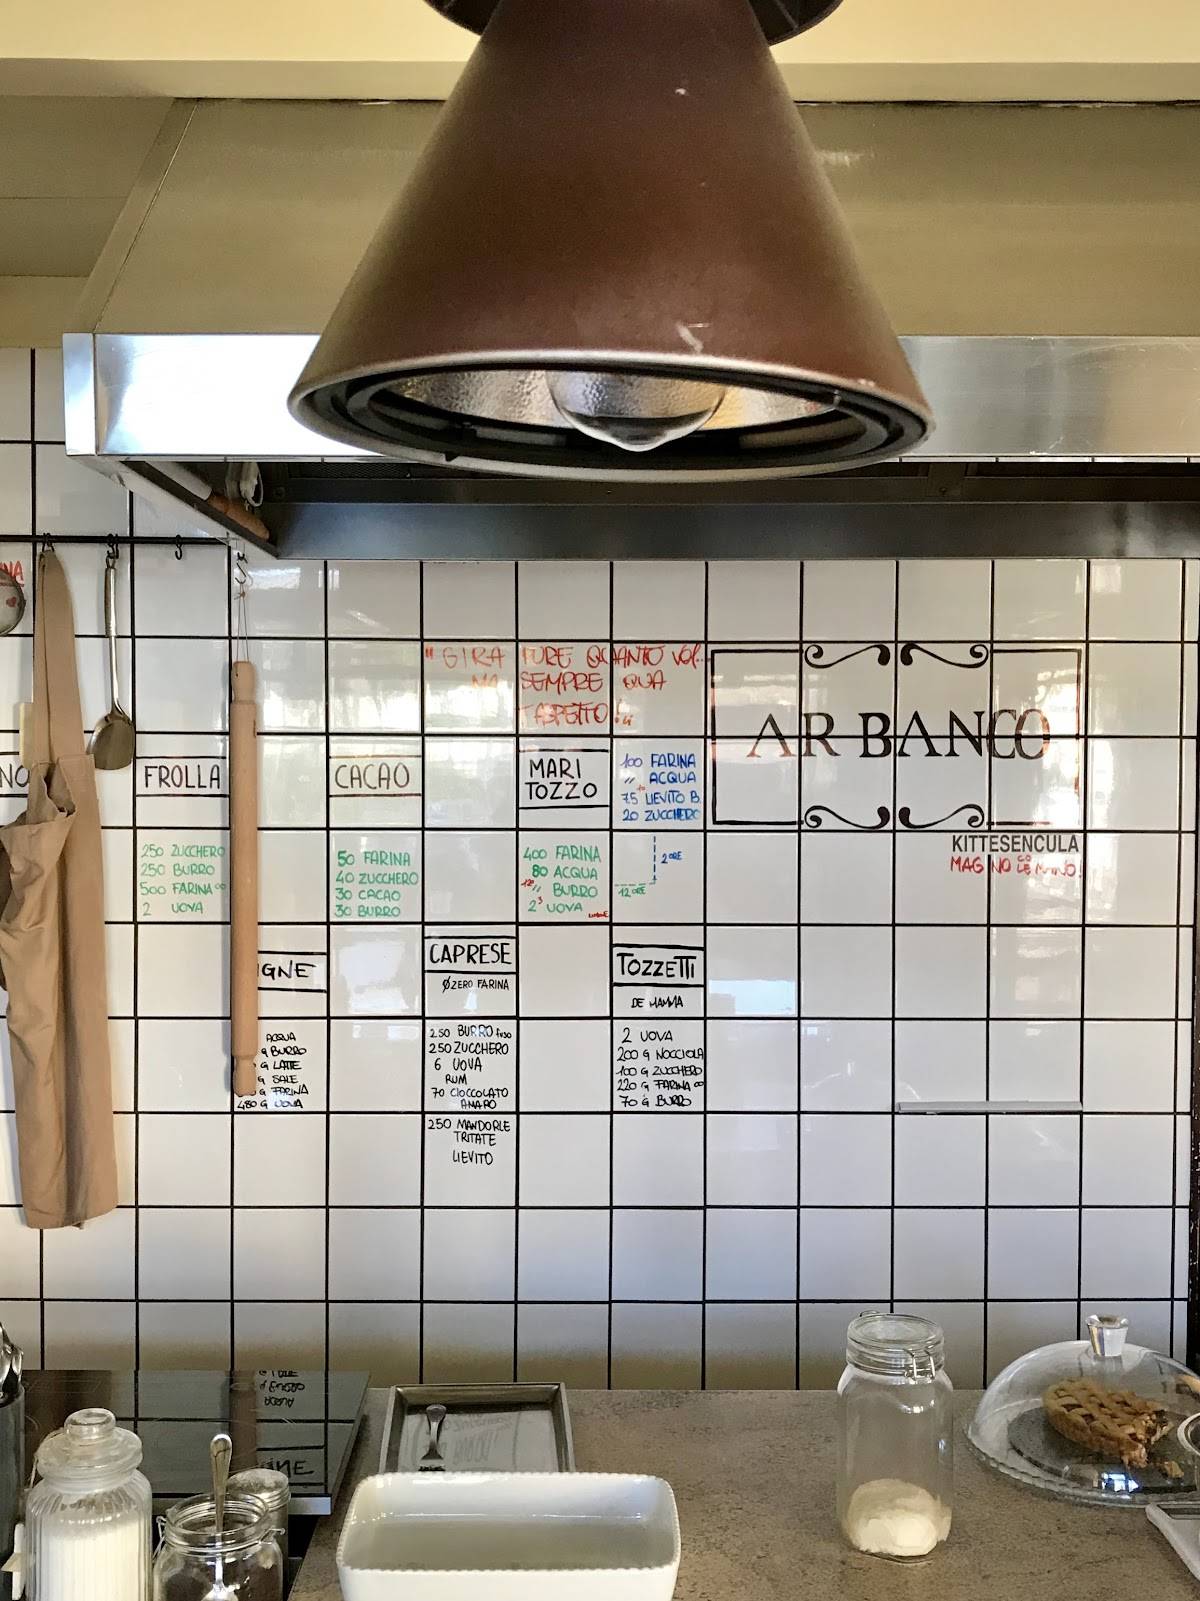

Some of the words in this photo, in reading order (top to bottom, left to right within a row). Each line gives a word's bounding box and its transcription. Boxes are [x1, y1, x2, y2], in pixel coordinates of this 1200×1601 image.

[587, 644, 665, 669] QUANTO
[521, 671, 603, 695] SEMPRE
[623, 670, 667, 690] QUA
[746, 712, 840, 757] AR
[859, 708, 1050, 759] BANCO
[620, 753, 642, 768] 100
[651, 753, 696, 768] FARINA
[335, 762, 410, 789] CACAO
[530, 758, 580, 779] MARI
[144, 764, 220, 789] FROLLA
[650, 772, 696, 784] ACQUA
[525, 782, 597, 800] TOZZO
[646, 790, 685, 805] LIEVITO
[622, 808, 639, 821] 20
[644, 808, 700, 821] ZUCCHERO
[952, 835, 1079, 852] KITTESENCULA
[141, 844, 164, 858] 250
[171, 844, 225, 857] ZUCCHERO
[338, 850, 355, 866] 50
[364, 851, 410, 866] FARINA
[523, 848, 547, 861] 400
[556, 846, 600, 862] FARINA
[141, 863, 165, 876] 250
[173, 864, 214, 876] BURRO
[532, 864, 548, 877] 80
[554, 866, 598, 880] ACQUA
[336, 871, 354, 884] 40
[358, 872, 418, 885] ZUCCHERO
[140, 882, 166, 895] 500
[172, 883, 212, 896] FARINA
[336, 888, 352, 900] 30
[358, 889, 400, 901] CACAO
[553, 883, 598, 898] BURRO
[143, 903, 151, 916] 2
[172, 903, 203, 914] UOVA
[335, 904, 352, 917] 30
[358, 905, 400, 917] BURRO
[528, 900, 536, 912] 2
[546, 903, 582, 913] UOVA
[430, 943, 512, 964] CAPRESE
[616, 952, 696, 980] TOZZETTI
[478, 979, 509, 990] FARINA
[631, 998, 645, 1008] DE
[266, 1032, 296, 1042] ACQUA
[430, 1028, 450, 1038] 250
[458, 1024, 494, 1038] BURRO
[622, 1028, 632, 1043] 2
[640, 1030, 672, 1042] UOVA
[270, 1046, 306, 1056] BURRO
[428, 1043, 452, 1054] 250
[454, 1041, 508, 1054] ZUCCHERO
[616, 1047, 638, 1061] 200
[643, 1050, 650, 1061] G
[656, 1048, 704, 1060] NOCCIOLA
[273, 1060, 302, 1070] LATTE
[434, 1058, 441, 1070] 6
[452, 1057, 482, 1072] UOVA
[446, 1074, 467, 1084] RUM
[616, 1066, 637, 1076] 100
[641, 1068, 648, 1078] G
[652, 1066, 702, 1076] ZUCCHERO
[272, 1075, 298, 1084] SALE
[617, 1078, 636, 1091] 220
[641, 1082, 649, 1091] G
[654, 1080, 690, 1091] FARINA
[271, 1084, 308, 1096] FARINA
[431, 1088, 444, 1098] 70
[450, 1088, 508, 1098] CIOCCOLATO
[238, 1100, 257, 1110] 480
[260, 1100, 268, 1109] G
[461, 1100, 496, 1110] AMARO
[619, 1095, 637, 1107] 70
[655, 1095, 691, 1106] BURRO
[428, 1118, 452, 1130] 250
[457, 1119, 510, 1132] MANDORLE
[453, 1131, 496, 1146] TRITATE
[452, 1150, 493, 1165] LIEVITO
